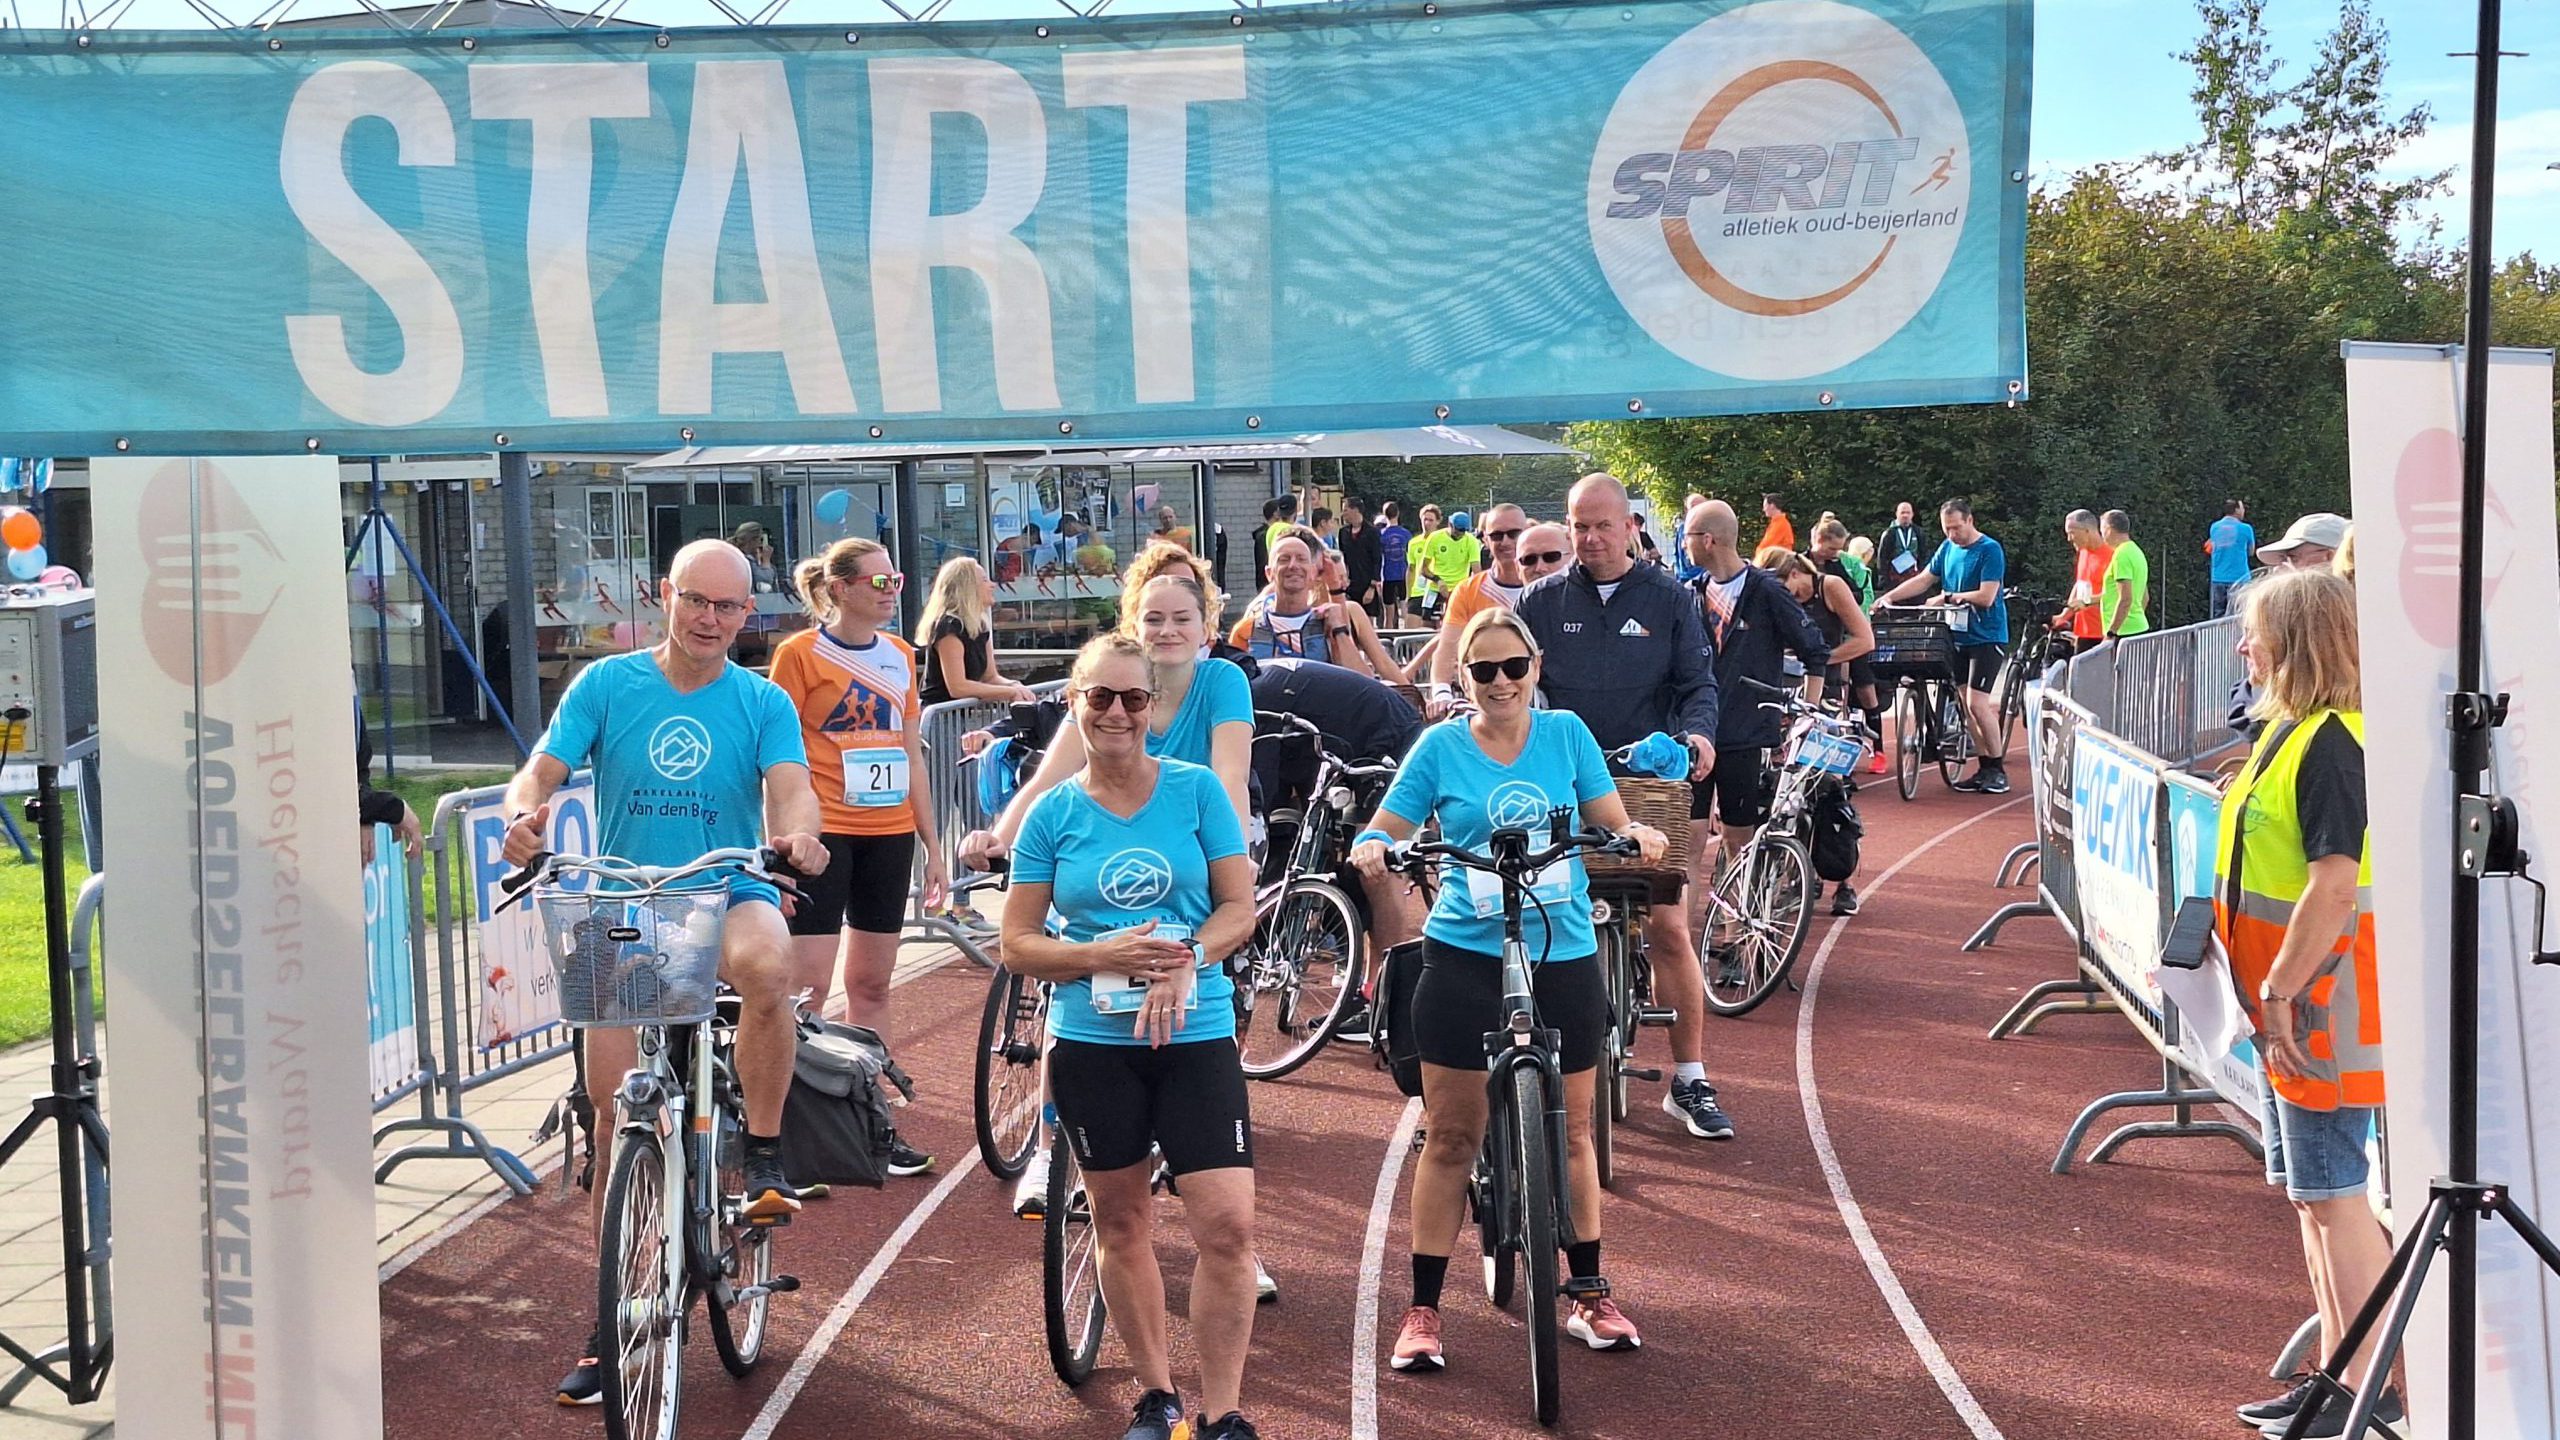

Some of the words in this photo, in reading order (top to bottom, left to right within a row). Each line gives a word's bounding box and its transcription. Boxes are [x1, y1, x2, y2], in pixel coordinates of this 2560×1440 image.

[1606, 137, 1919, 219] SPIRIT
[280, 44, 1247, 426] START
[1722, 216, 1798, 237] atletiek
[1805, 207, 1959, 233] oud-beijerland
[1563, 622, 1583, 633] 037
[869, 763, 891, 791] 21
[627, 800, 653, 816] Van
[659, 802, 688, 817] den
[474, 799, 591, 923] PO
[1234, 1119, 1246, 1152] FUSION
